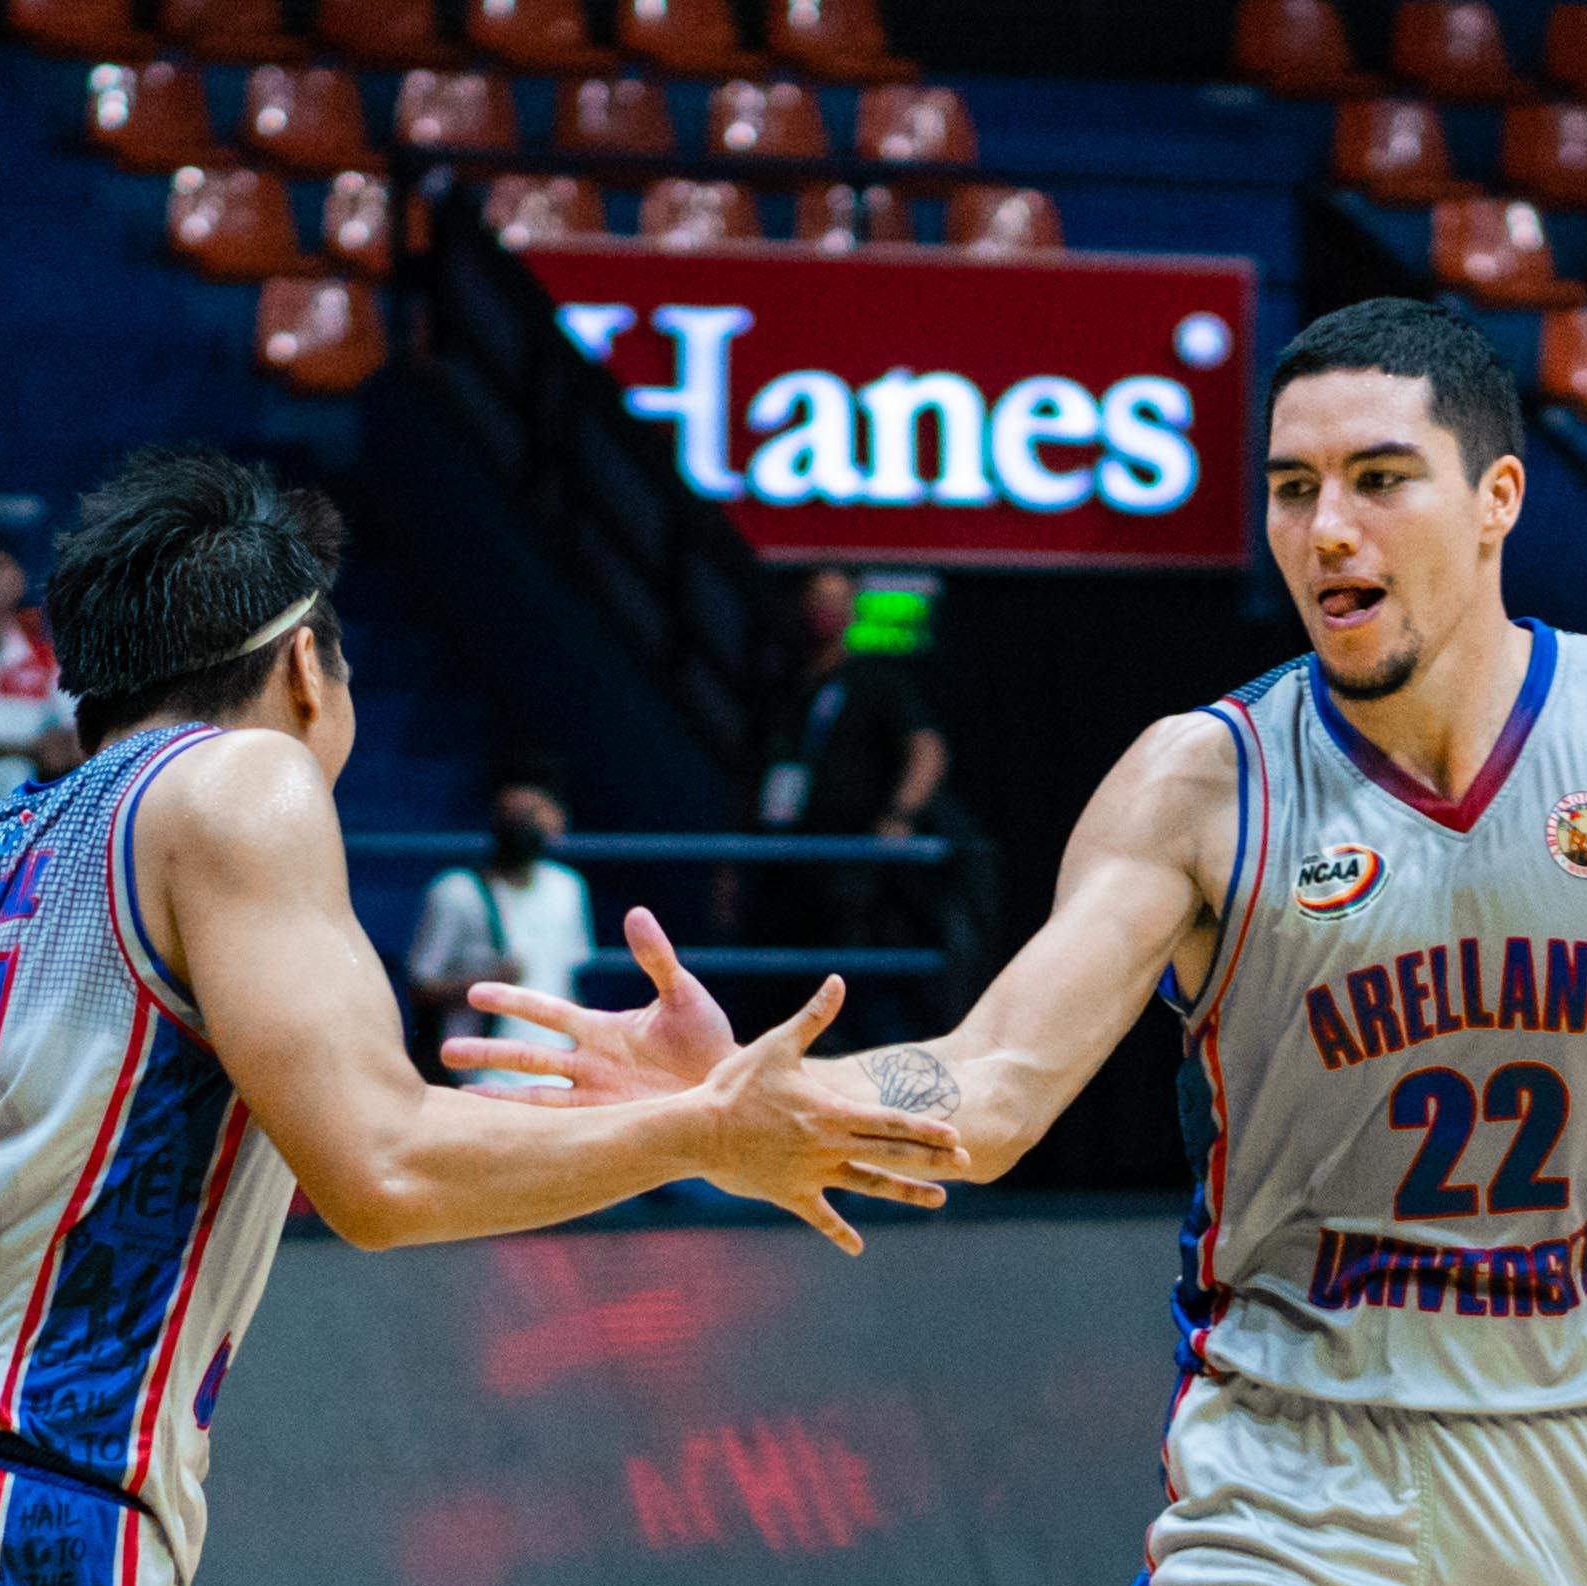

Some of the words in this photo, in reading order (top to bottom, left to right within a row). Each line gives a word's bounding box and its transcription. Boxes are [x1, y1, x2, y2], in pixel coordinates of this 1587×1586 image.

[555, 302, 1202, 514] Hanes
[1297, 857, 1360, 888] NCAA
[1387, 1059, 1571, 1222] 22
[19, 1503, 82, 1529] HAIL
